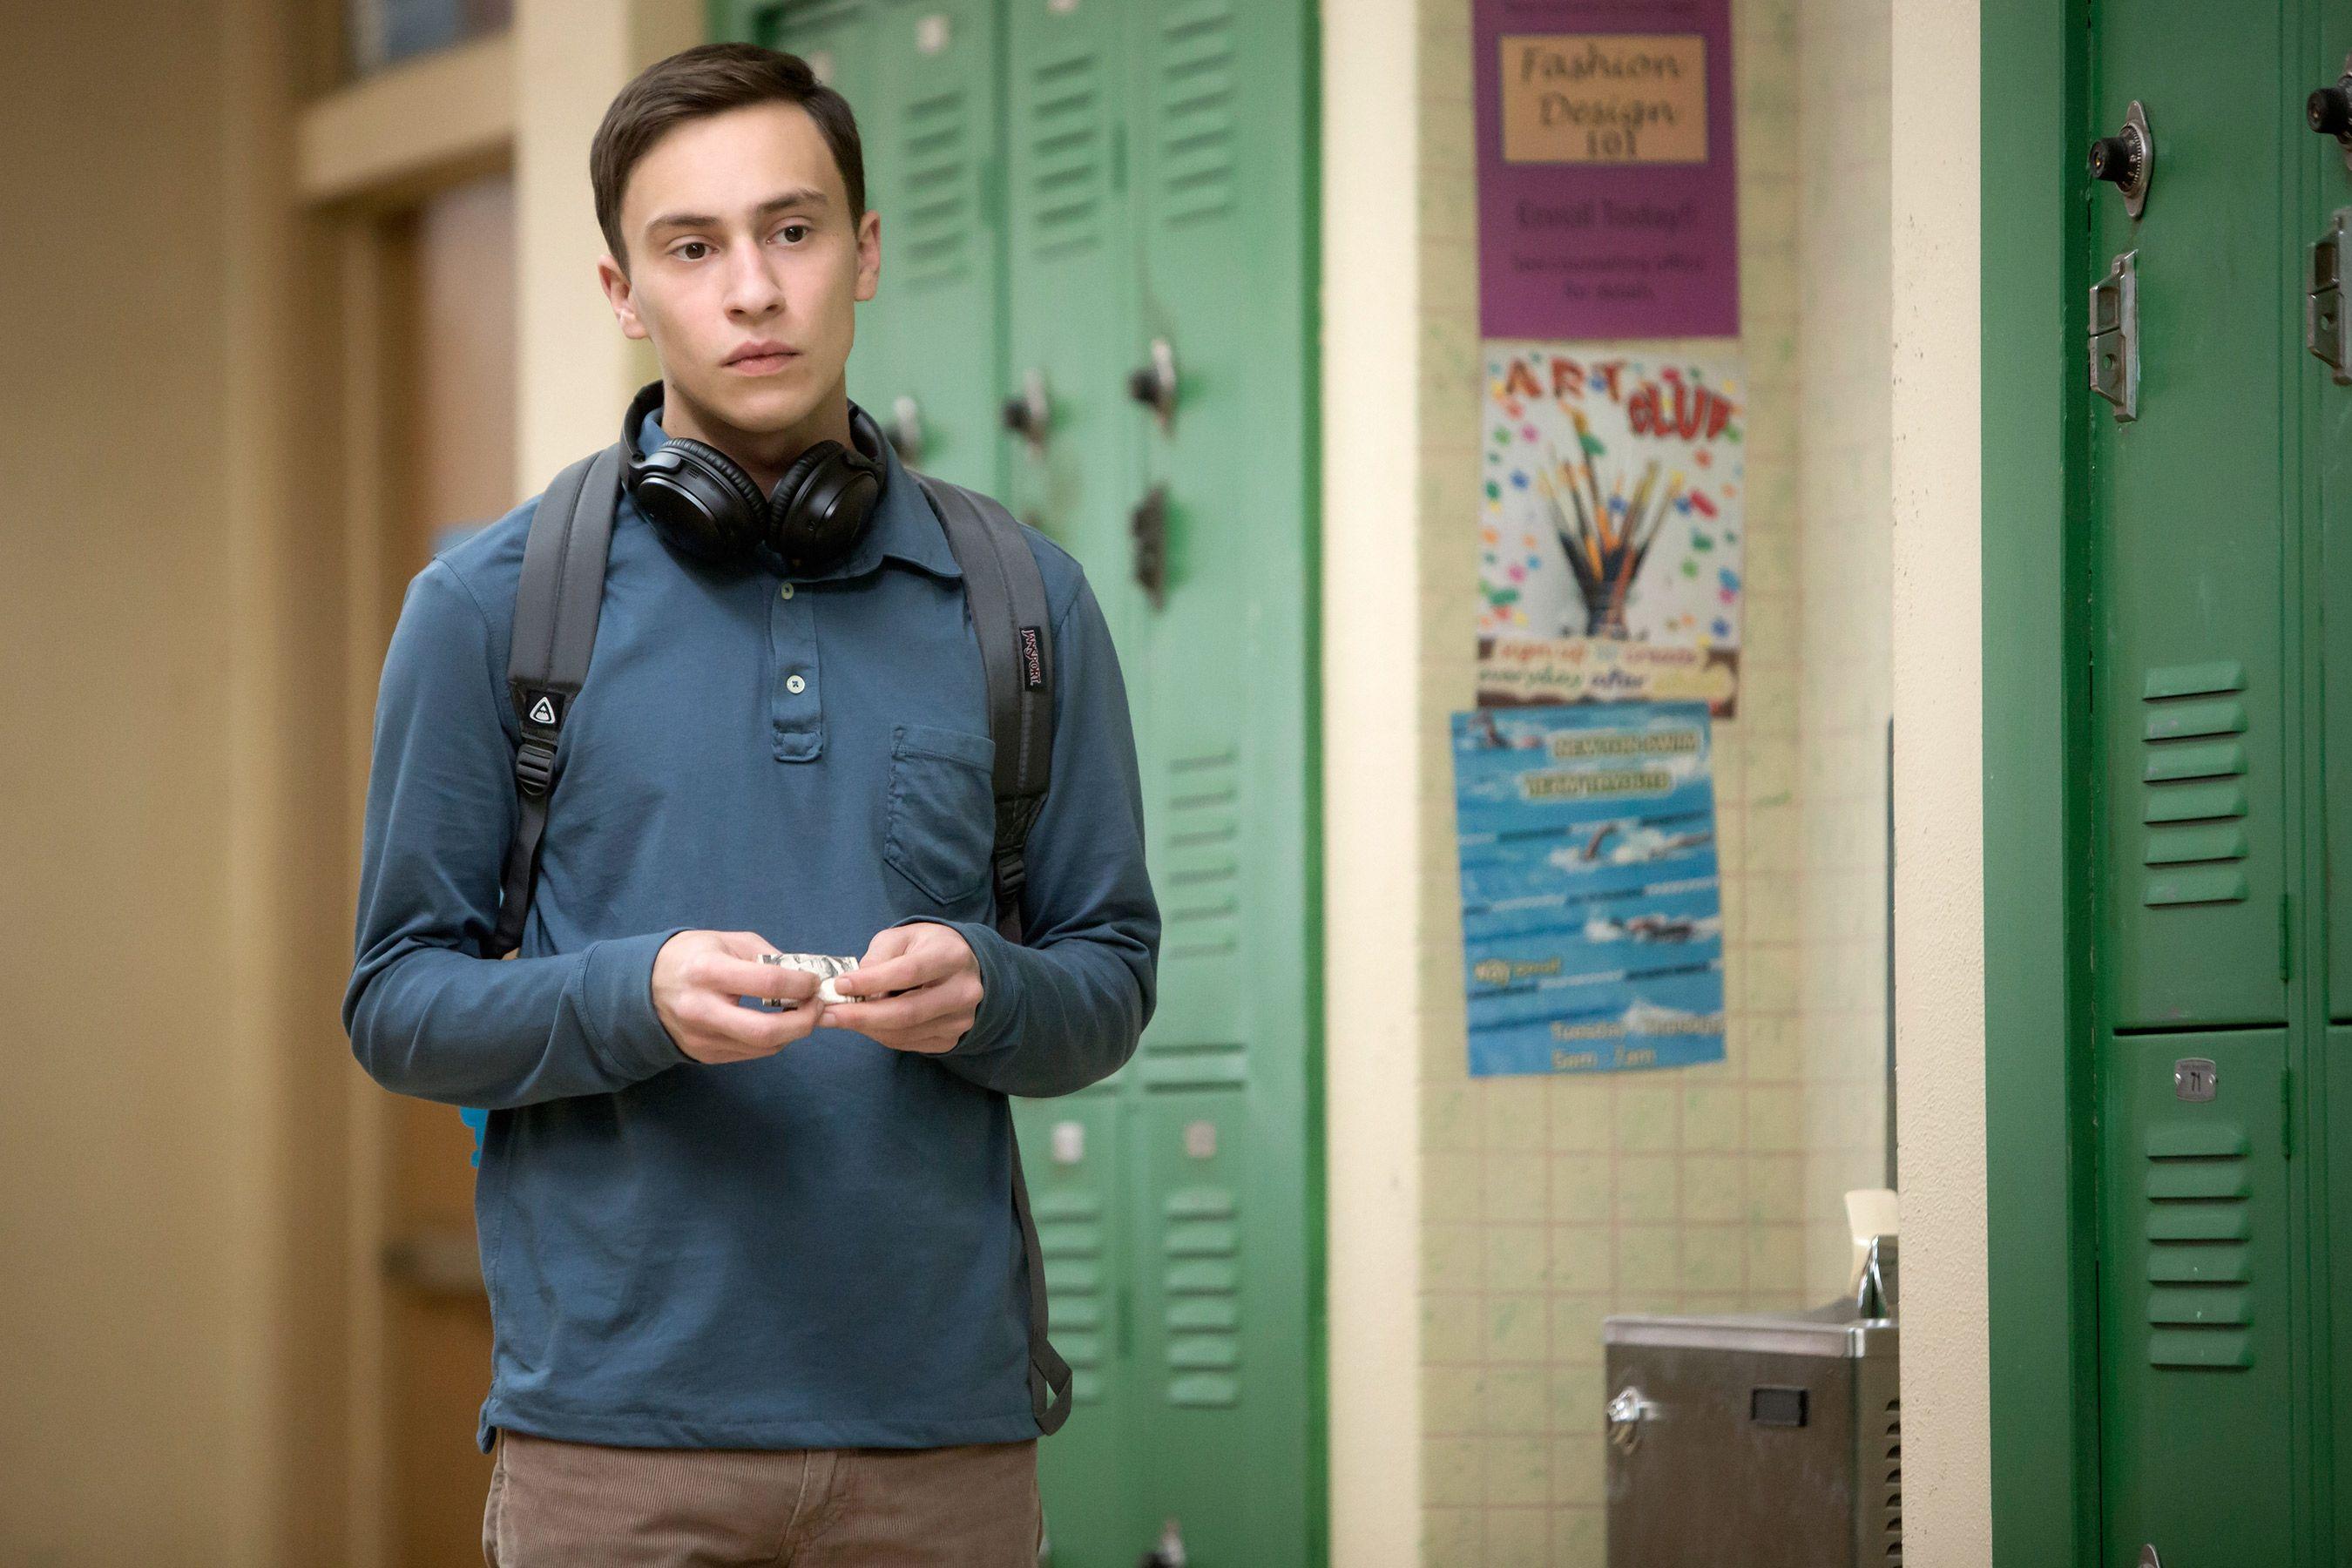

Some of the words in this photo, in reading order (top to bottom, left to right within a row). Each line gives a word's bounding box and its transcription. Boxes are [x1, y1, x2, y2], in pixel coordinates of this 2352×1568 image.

[1520, 41, 1681, 84] Fashion
[1538, 91, 1678, 129] Design
[1585, 128, 1637, 157] 101
[1505, 356, 1628, 402] ART
[1628, 380, 1733, 441] CLUB
[1590, 666, 1646, 689] after
